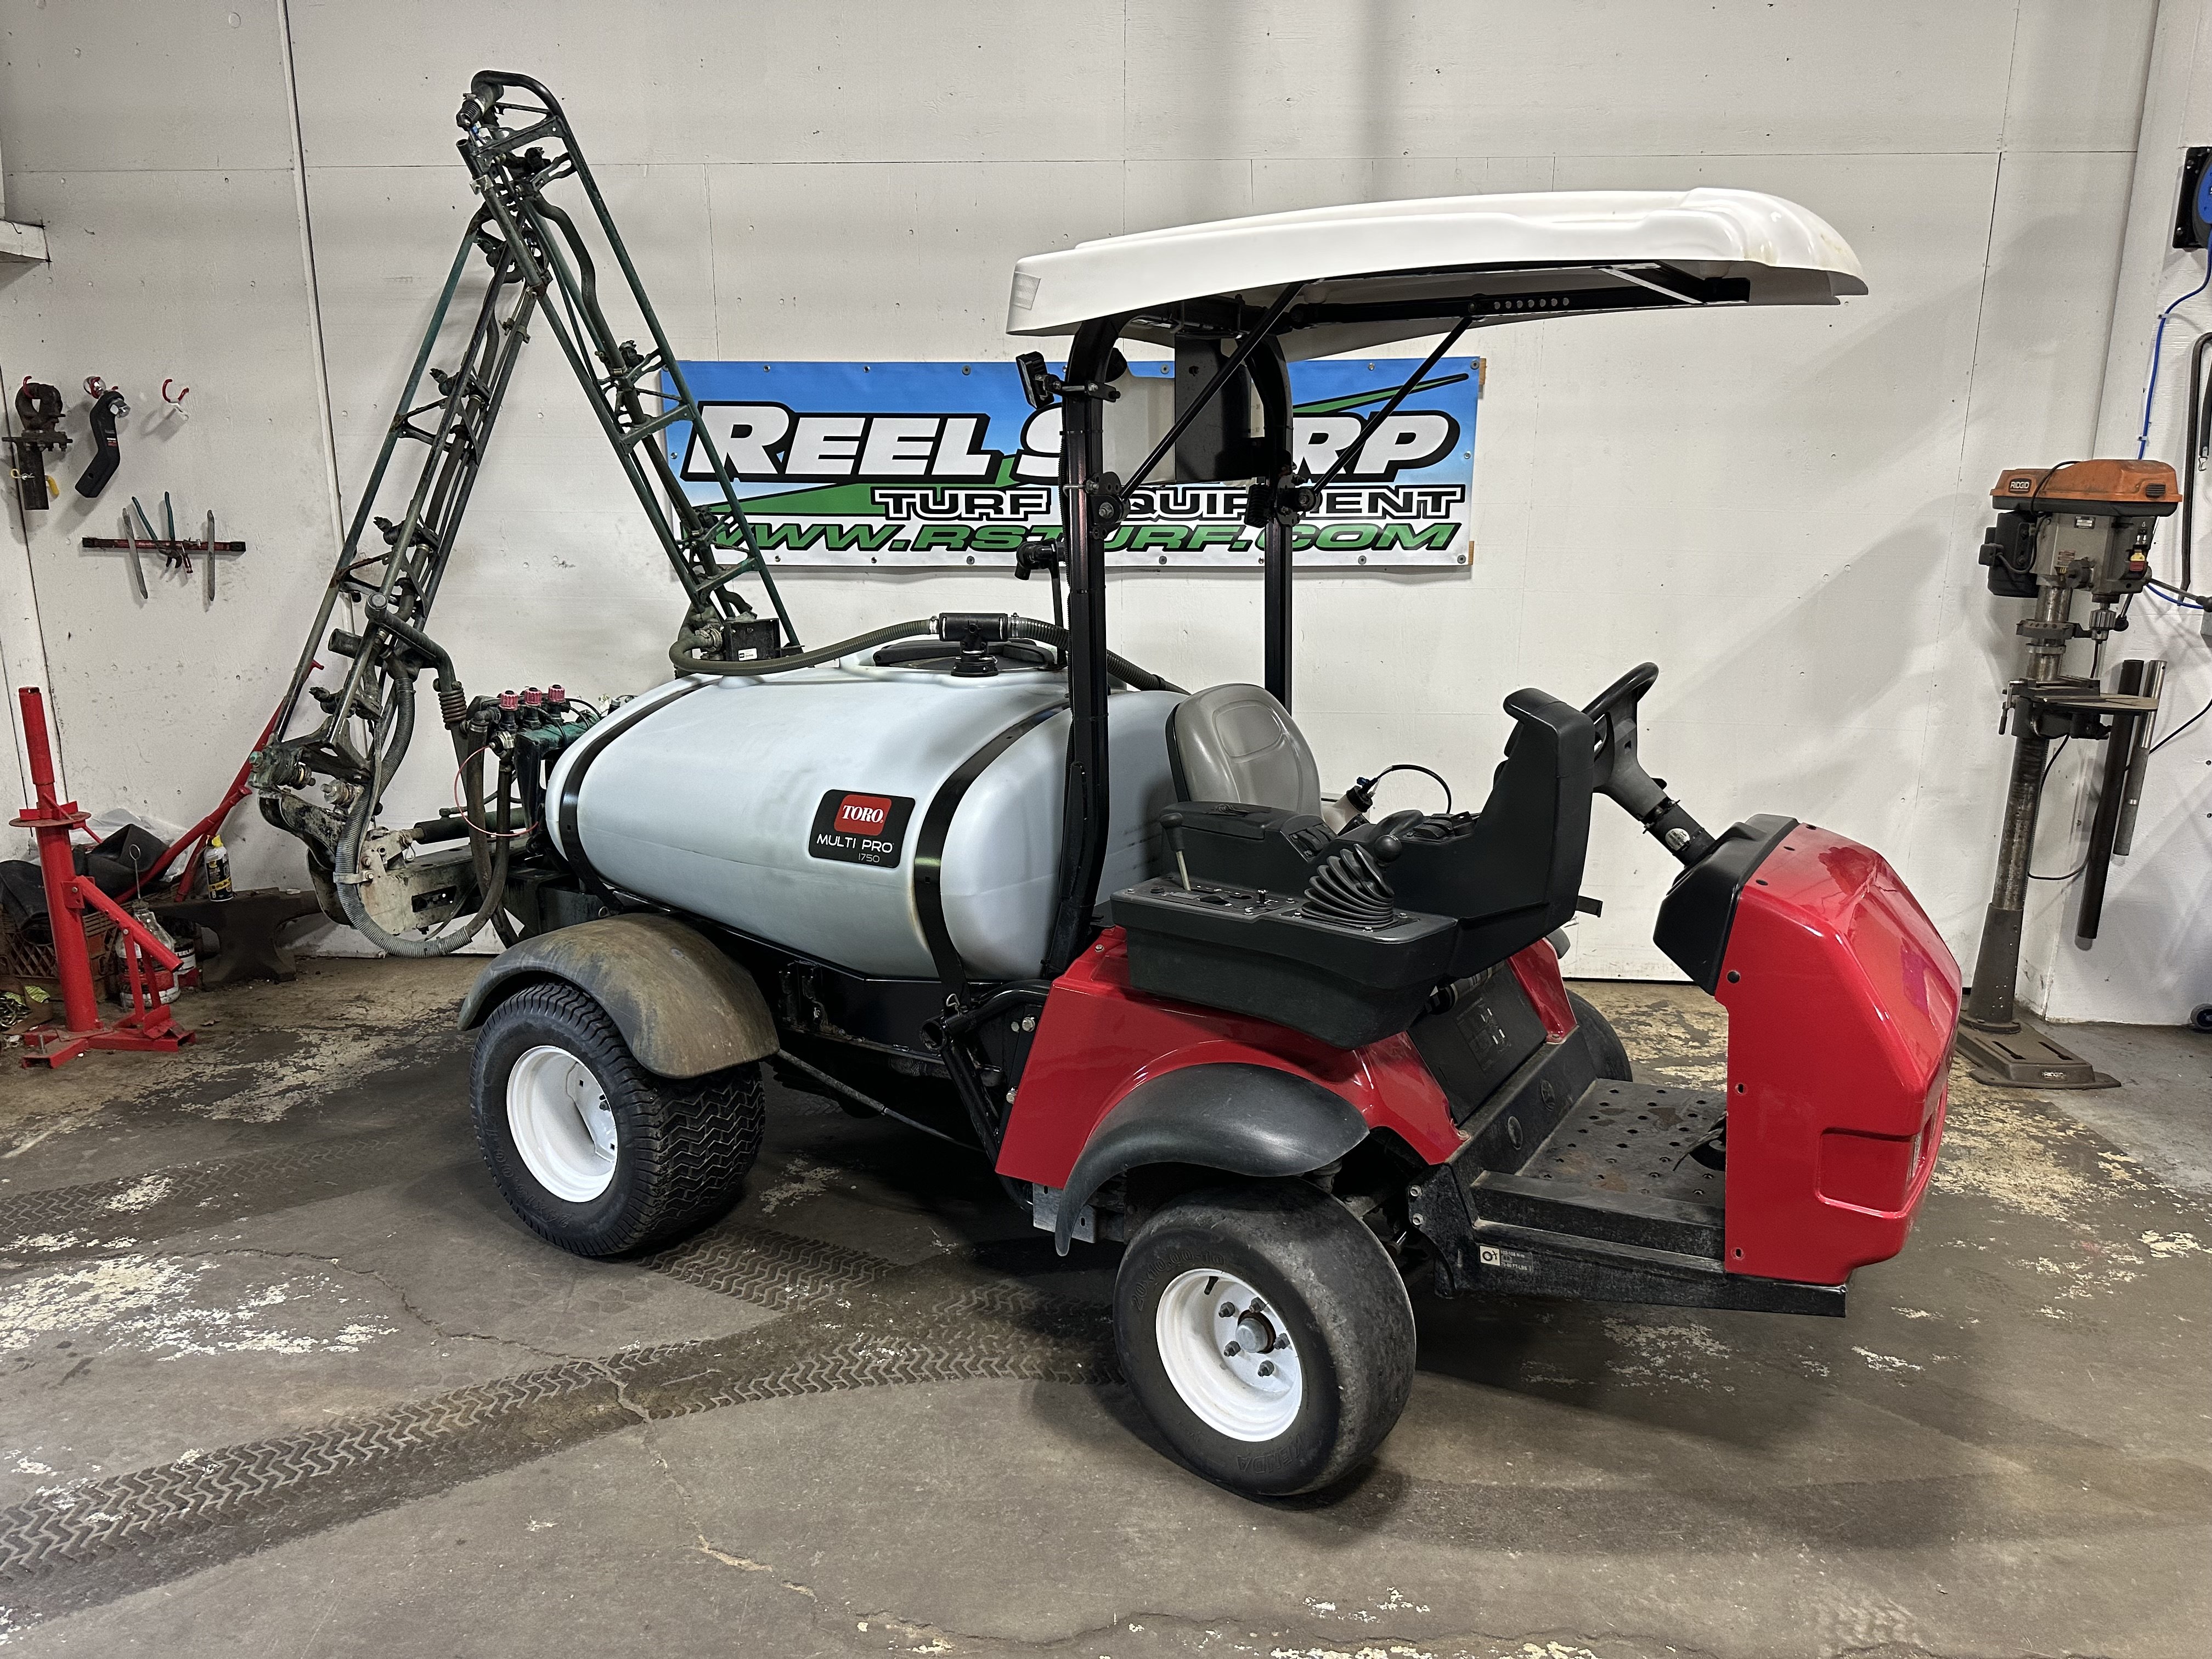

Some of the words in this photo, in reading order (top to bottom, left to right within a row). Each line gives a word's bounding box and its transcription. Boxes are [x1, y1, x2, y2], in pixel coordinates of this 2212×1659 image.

[682, 402, 1002, 482] REEL
[872, 487, 1052, 521] TURF
[1122, 486, 1464, 521] QUIPENT
[842, 805, 883, 823] TORO
[816, 833, 856, 849] MULTI
[861, 839, 893, 853] PRO
[858, 853, 881, 863] 1750
